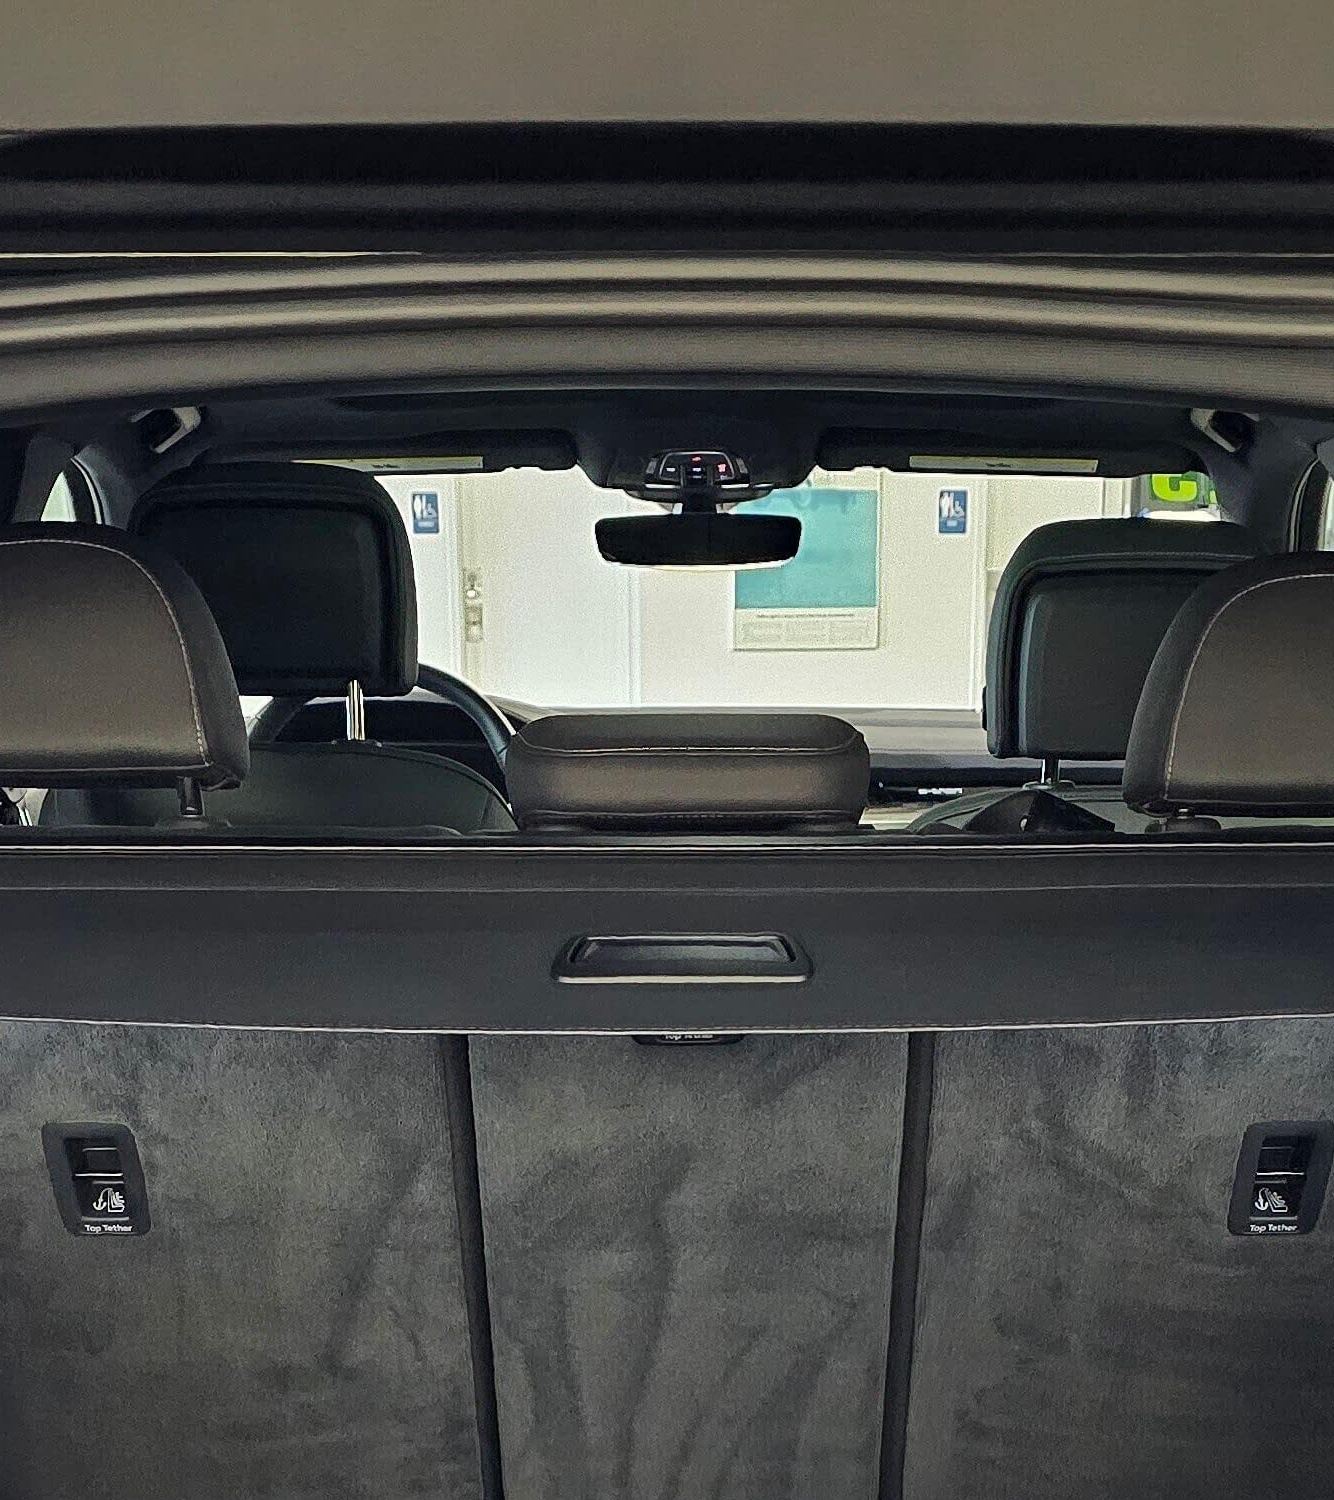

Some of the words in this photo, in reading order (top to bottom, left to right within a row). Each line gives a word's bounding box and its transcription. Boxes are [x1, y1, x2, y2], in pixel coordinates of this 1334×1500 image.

[84, 1224, 101, 1234] Top
[102, 1224, 133, 1232] Tether
[1249, 1224, 1267, 1234] Top
[1268, 1224, 1298, 1232] Tether
